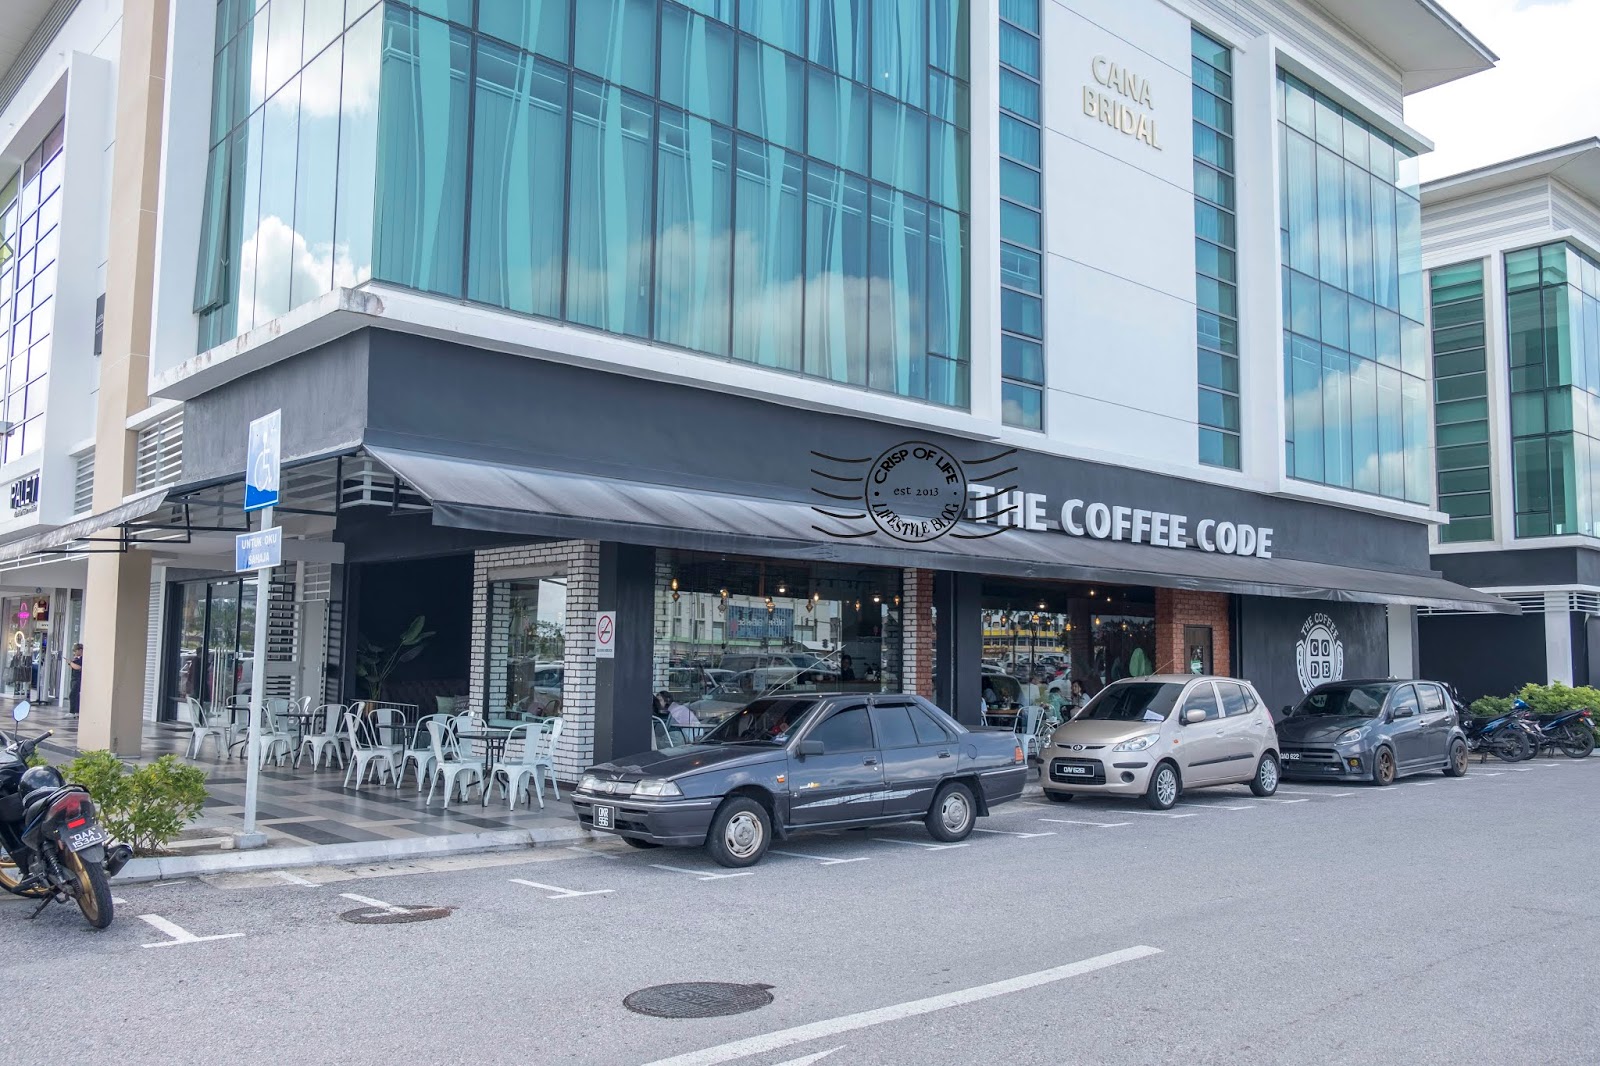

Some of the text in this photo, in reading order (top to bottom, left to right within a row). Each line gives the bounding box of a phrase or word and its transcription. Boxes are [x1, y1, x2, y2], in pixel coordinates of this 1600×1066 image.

[1092, 54, 1154, 110] CANA
[1083, 85, 1162, 151] BRIDAL
[967, 483, 1274, 558] THE COFFEE CODE
[241, 533, 277, 549] UNTUK OKU
[248, 551, 270, 565] SAHAJA
[1301, 612, 1339, 640] THE COFFEE
[73, 829, 95, 841] QAA
